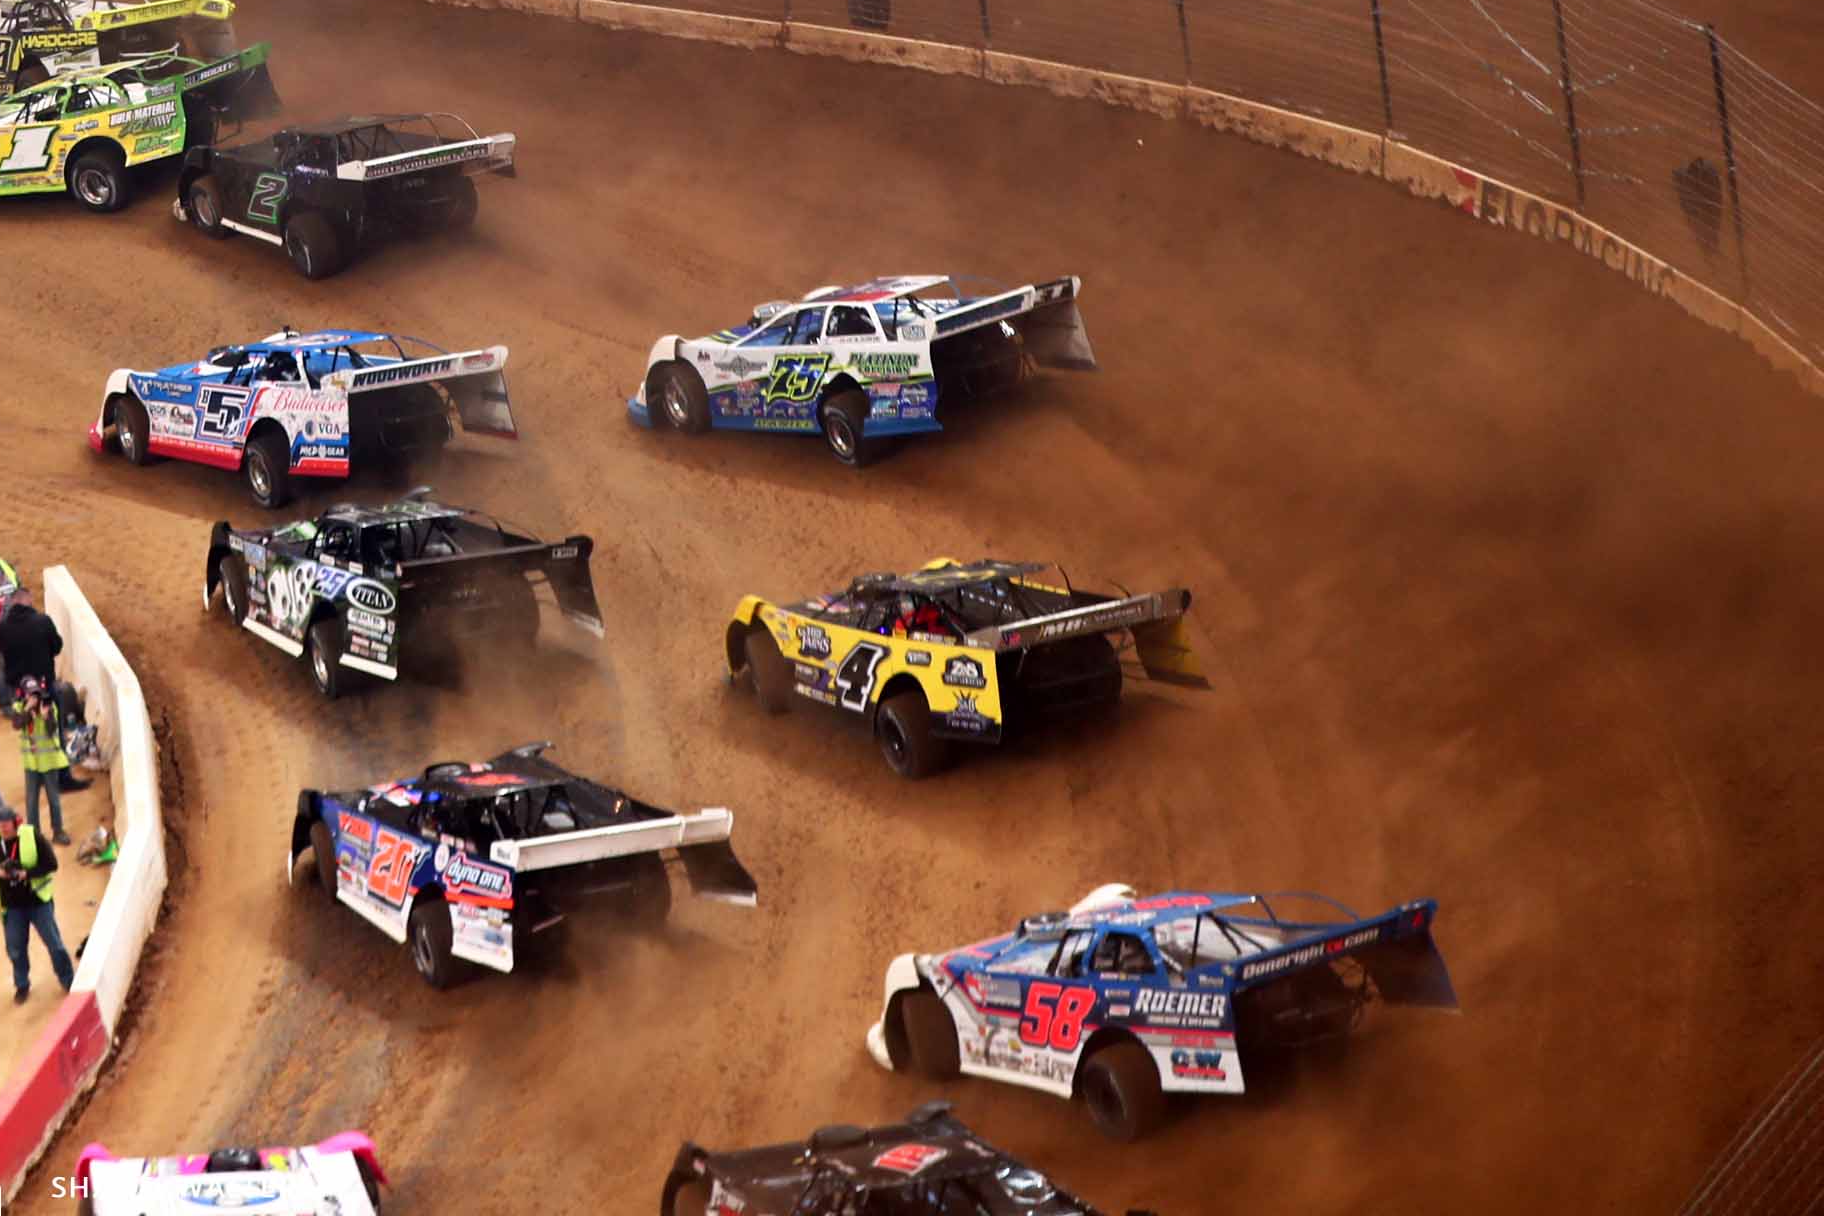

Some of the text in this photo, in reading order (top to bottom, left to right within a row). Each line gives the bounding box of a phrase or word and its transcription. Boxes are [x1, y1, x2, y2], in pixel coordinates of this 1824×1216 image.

[21, 31, 97, 48] HARDCORE
[0, 127, 56, 174] 1
[247, 172, 287, 224] 2
[353, 360, 452, 388] WOODWORTH
[848, 351, 921, 369] PLATINUM
[273, 391, 346, 413] Budweiser
[355, 585, 391, 608] TITAN
[836, 642, 889, 712] 4
[1135, 988, 1225, 1017] ROEMER
[1021, 984, 1097, 1051] 58
